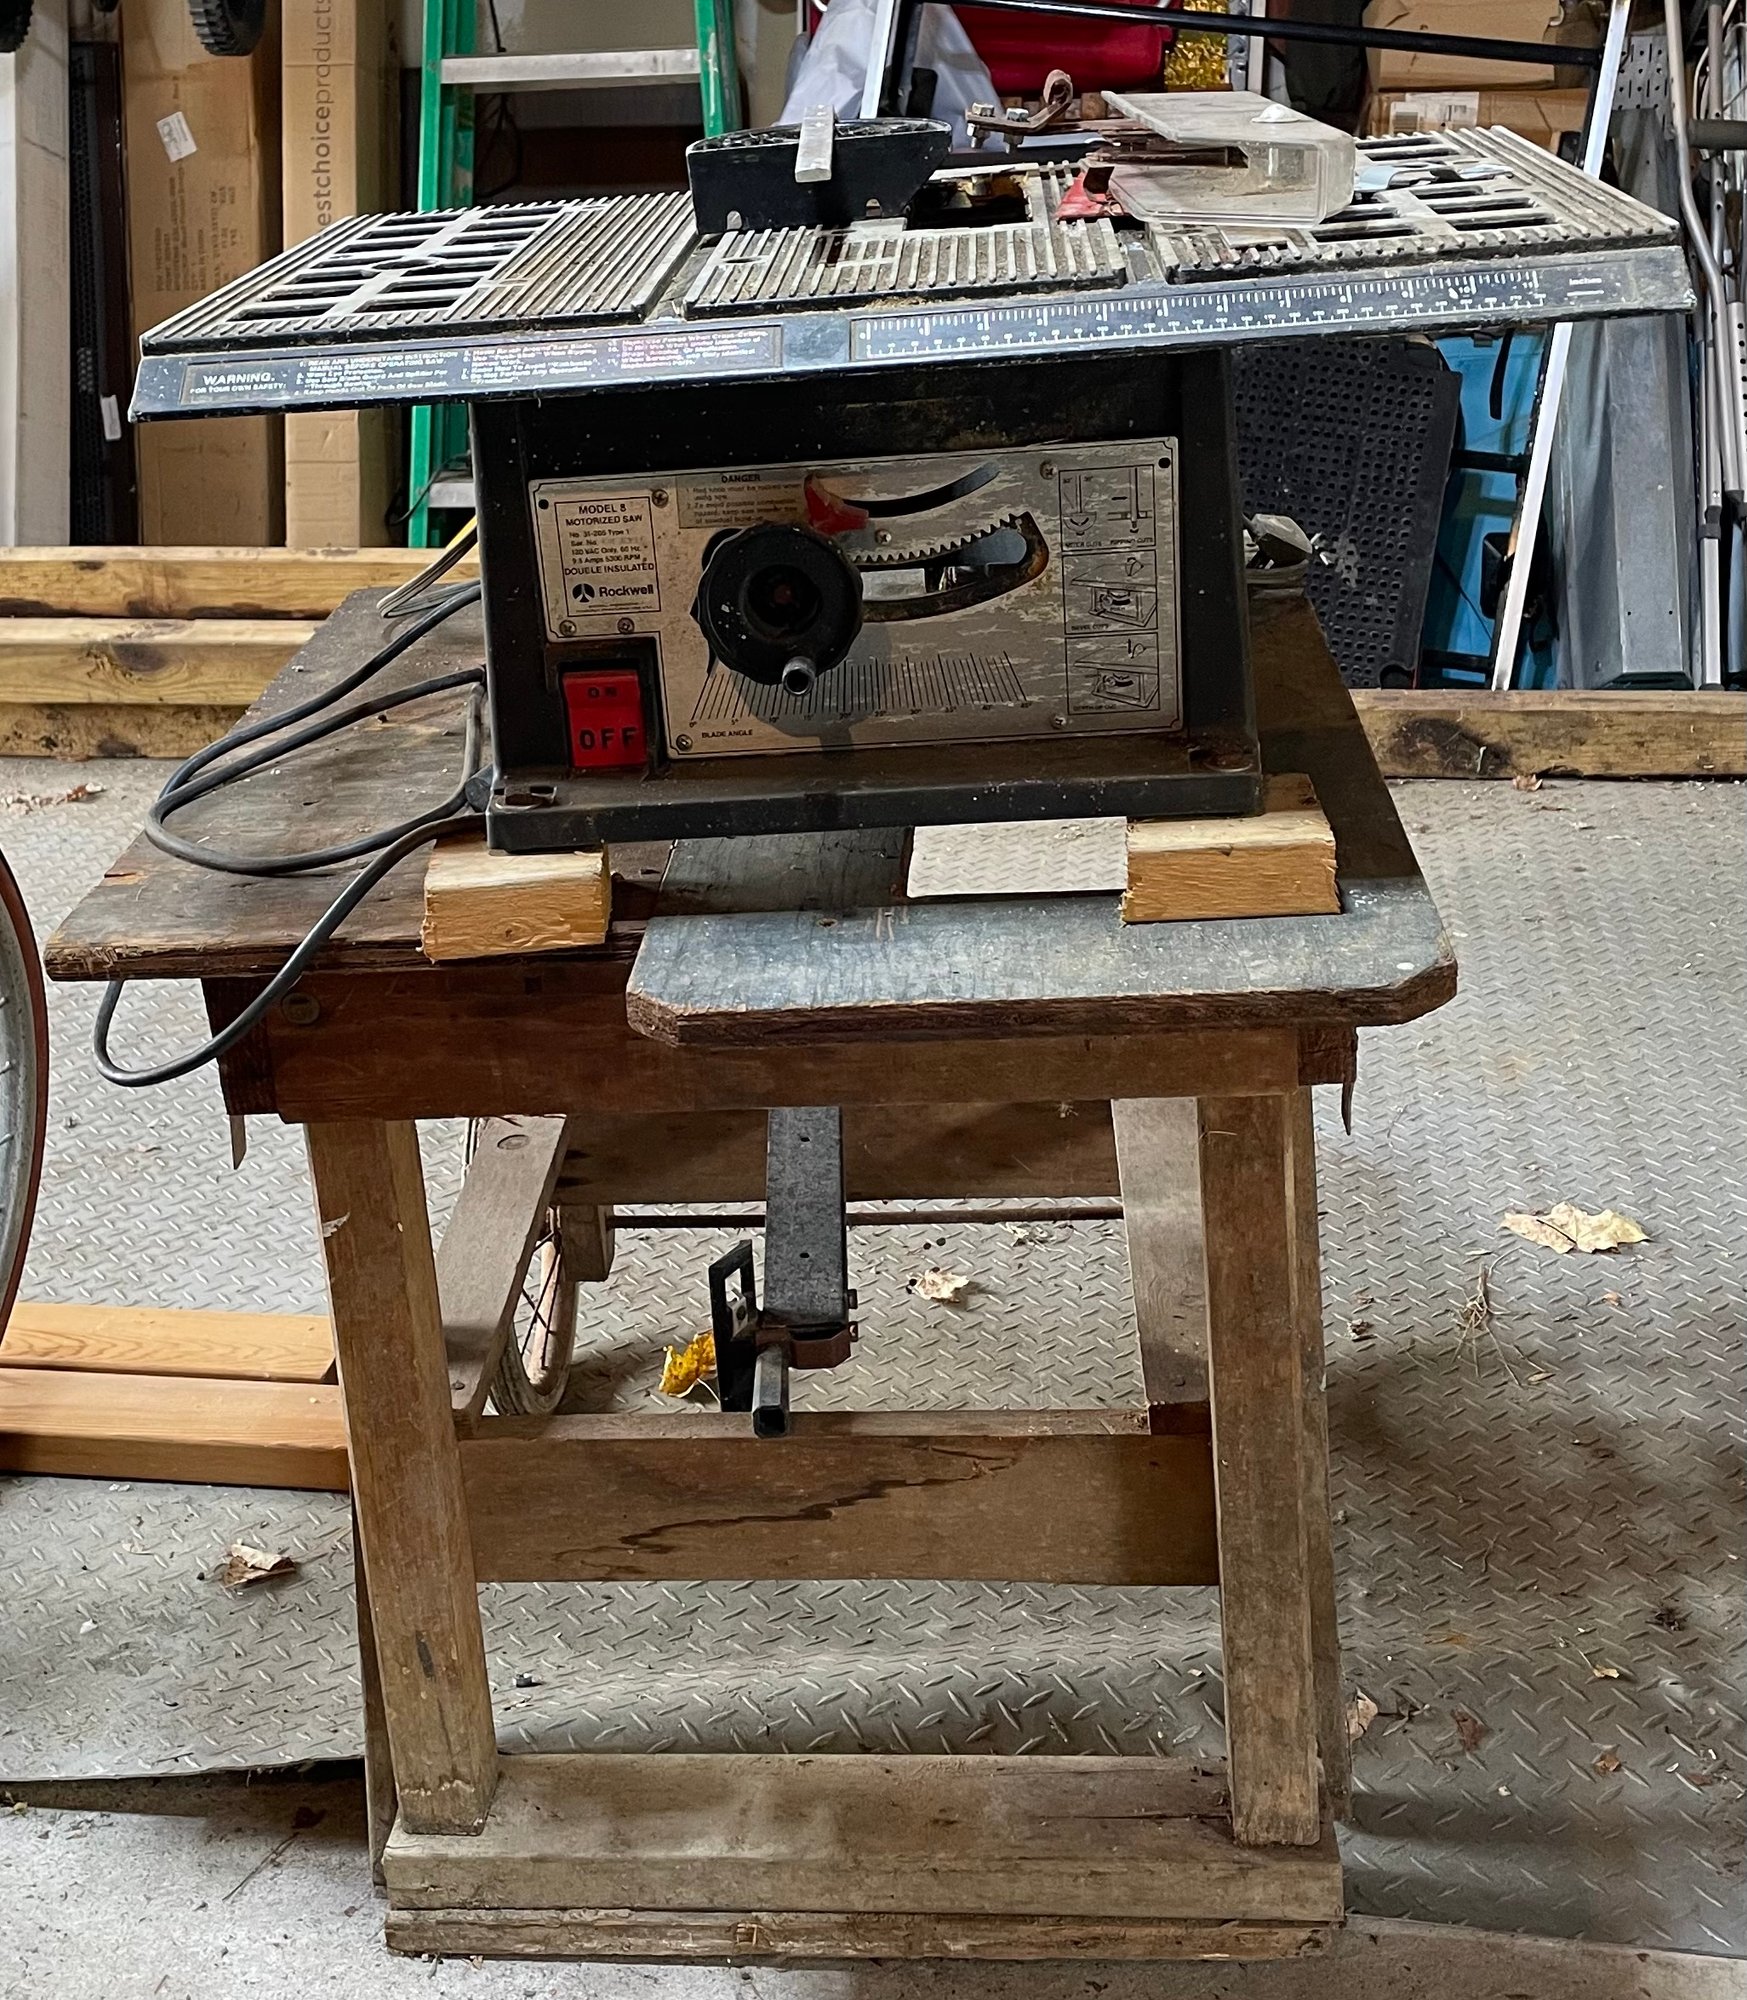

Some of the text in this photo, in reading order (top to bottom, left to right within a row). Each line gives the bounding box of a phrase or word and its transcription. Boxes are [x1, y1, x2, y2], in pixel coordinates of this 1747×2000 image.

[312, 0, 334, 226] estchoiceproduct
[721, 474, 761, 484] DANGER
[578, 503, 627, 515] MODEL 8
[565, 514, 643, 526] MOTORIZED SAW
[607, 529, 624, 537] Type
[571, 548, 584, 556] 120
[585, 547, 600, 555] VAC
[564, 563, 655, 576] DOUBLE INSULATED
[598, 584, 655, 598] Rockwell
[579, 726, 638, 751] OFF
[701, 729, 753, 739] BLADE ANGLE
